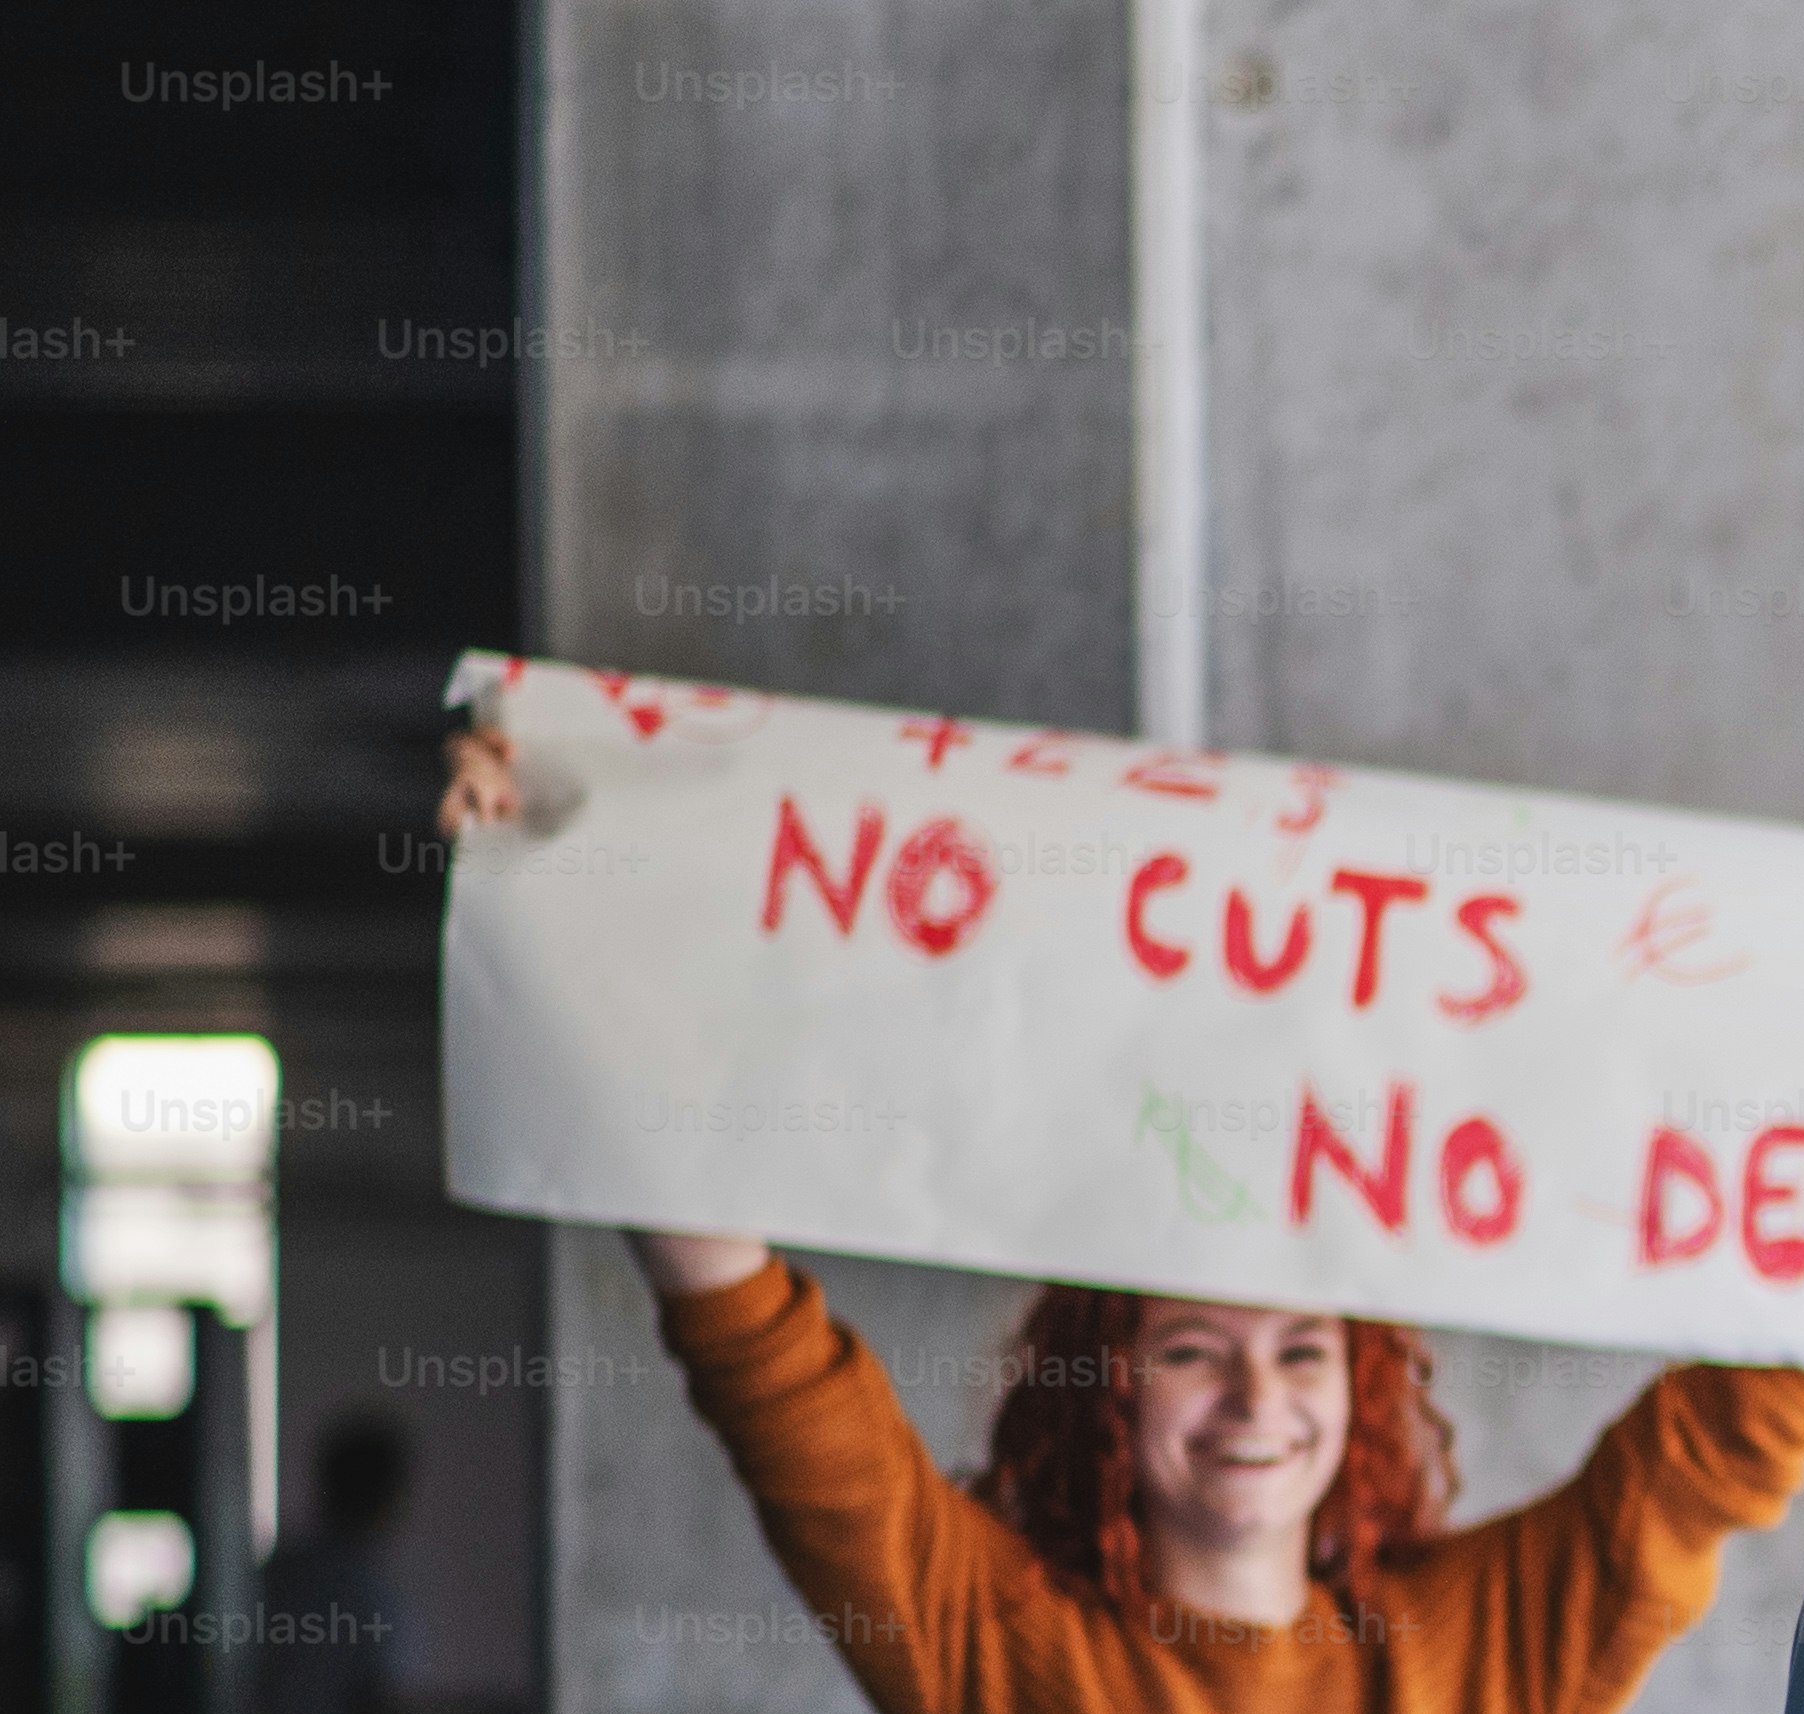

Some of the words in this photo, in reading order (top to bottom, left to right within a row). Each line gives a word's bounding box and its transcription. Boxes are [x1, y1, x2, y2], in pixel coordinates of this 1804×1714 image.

[757, 796, 999, 959] NO
[1123, 852, 1529, 1026] CUTS
[1287, 1076, 1527, 1249] NO
